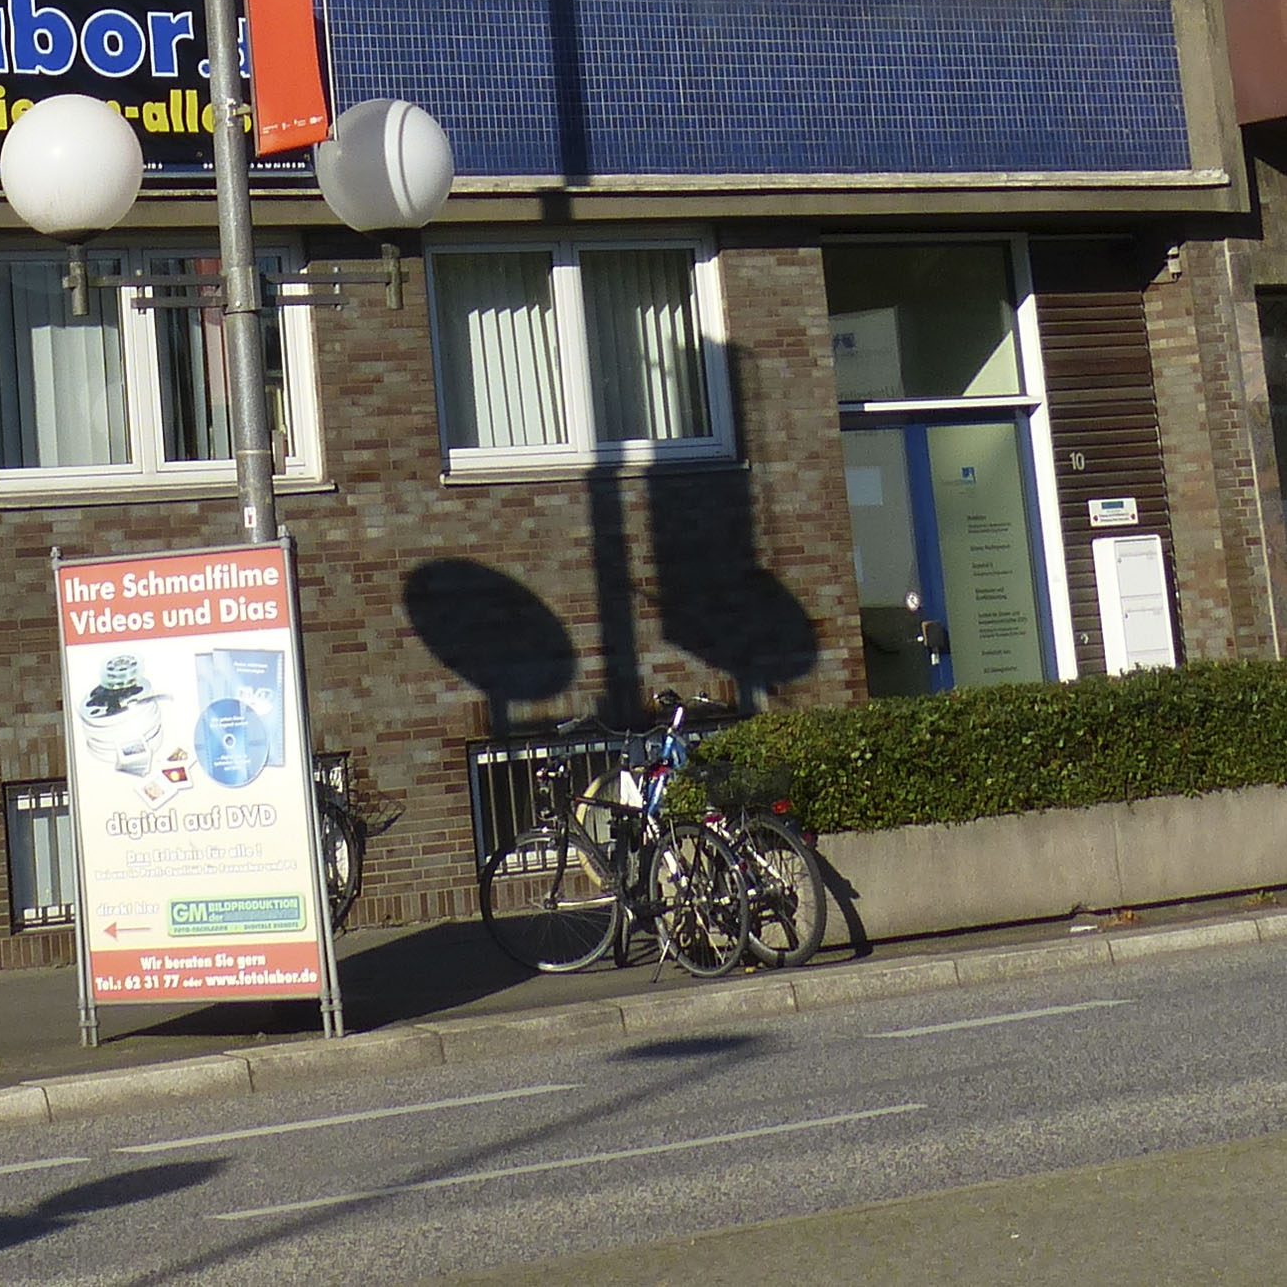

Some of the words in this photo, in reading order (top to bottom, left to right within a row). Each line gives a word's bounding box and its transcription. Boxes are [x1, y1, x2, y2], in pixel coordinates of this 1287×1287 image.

[1069, 452, 1085, 471] 10
[65, 578, 115, 604] Ihre
[122, 563, 280, 598] Schmalfilme
[69, 606, 155, 636] Videos
[163, 599, 211, 628] und
[219, 596, 279, 624] Dias
[106, 808, 179, 840] digital
[183, 805, 221, 832] auf
[226, 804, 277, 829] DVD
[127, 850, 151, 866] Das
[97, 902, 133, 916] direkt
[172, 902, 208, 923] GM
[208, 897, 298, 913] BILDPRODUKTION
[140, 956, 163, 971] Wir
[164, 954, 212, 970] beraten
[215, 953, 234, 967] Sie
[237, 954, 266, 970] gern
[95, 975, 122, 992] Tel.:
[124, 974, 141, 990] 62
[144, 974, 159, 989] 31
[163, 973, 180, 988] 77
[204, 968, 318, 987] www.fotolabor.de
